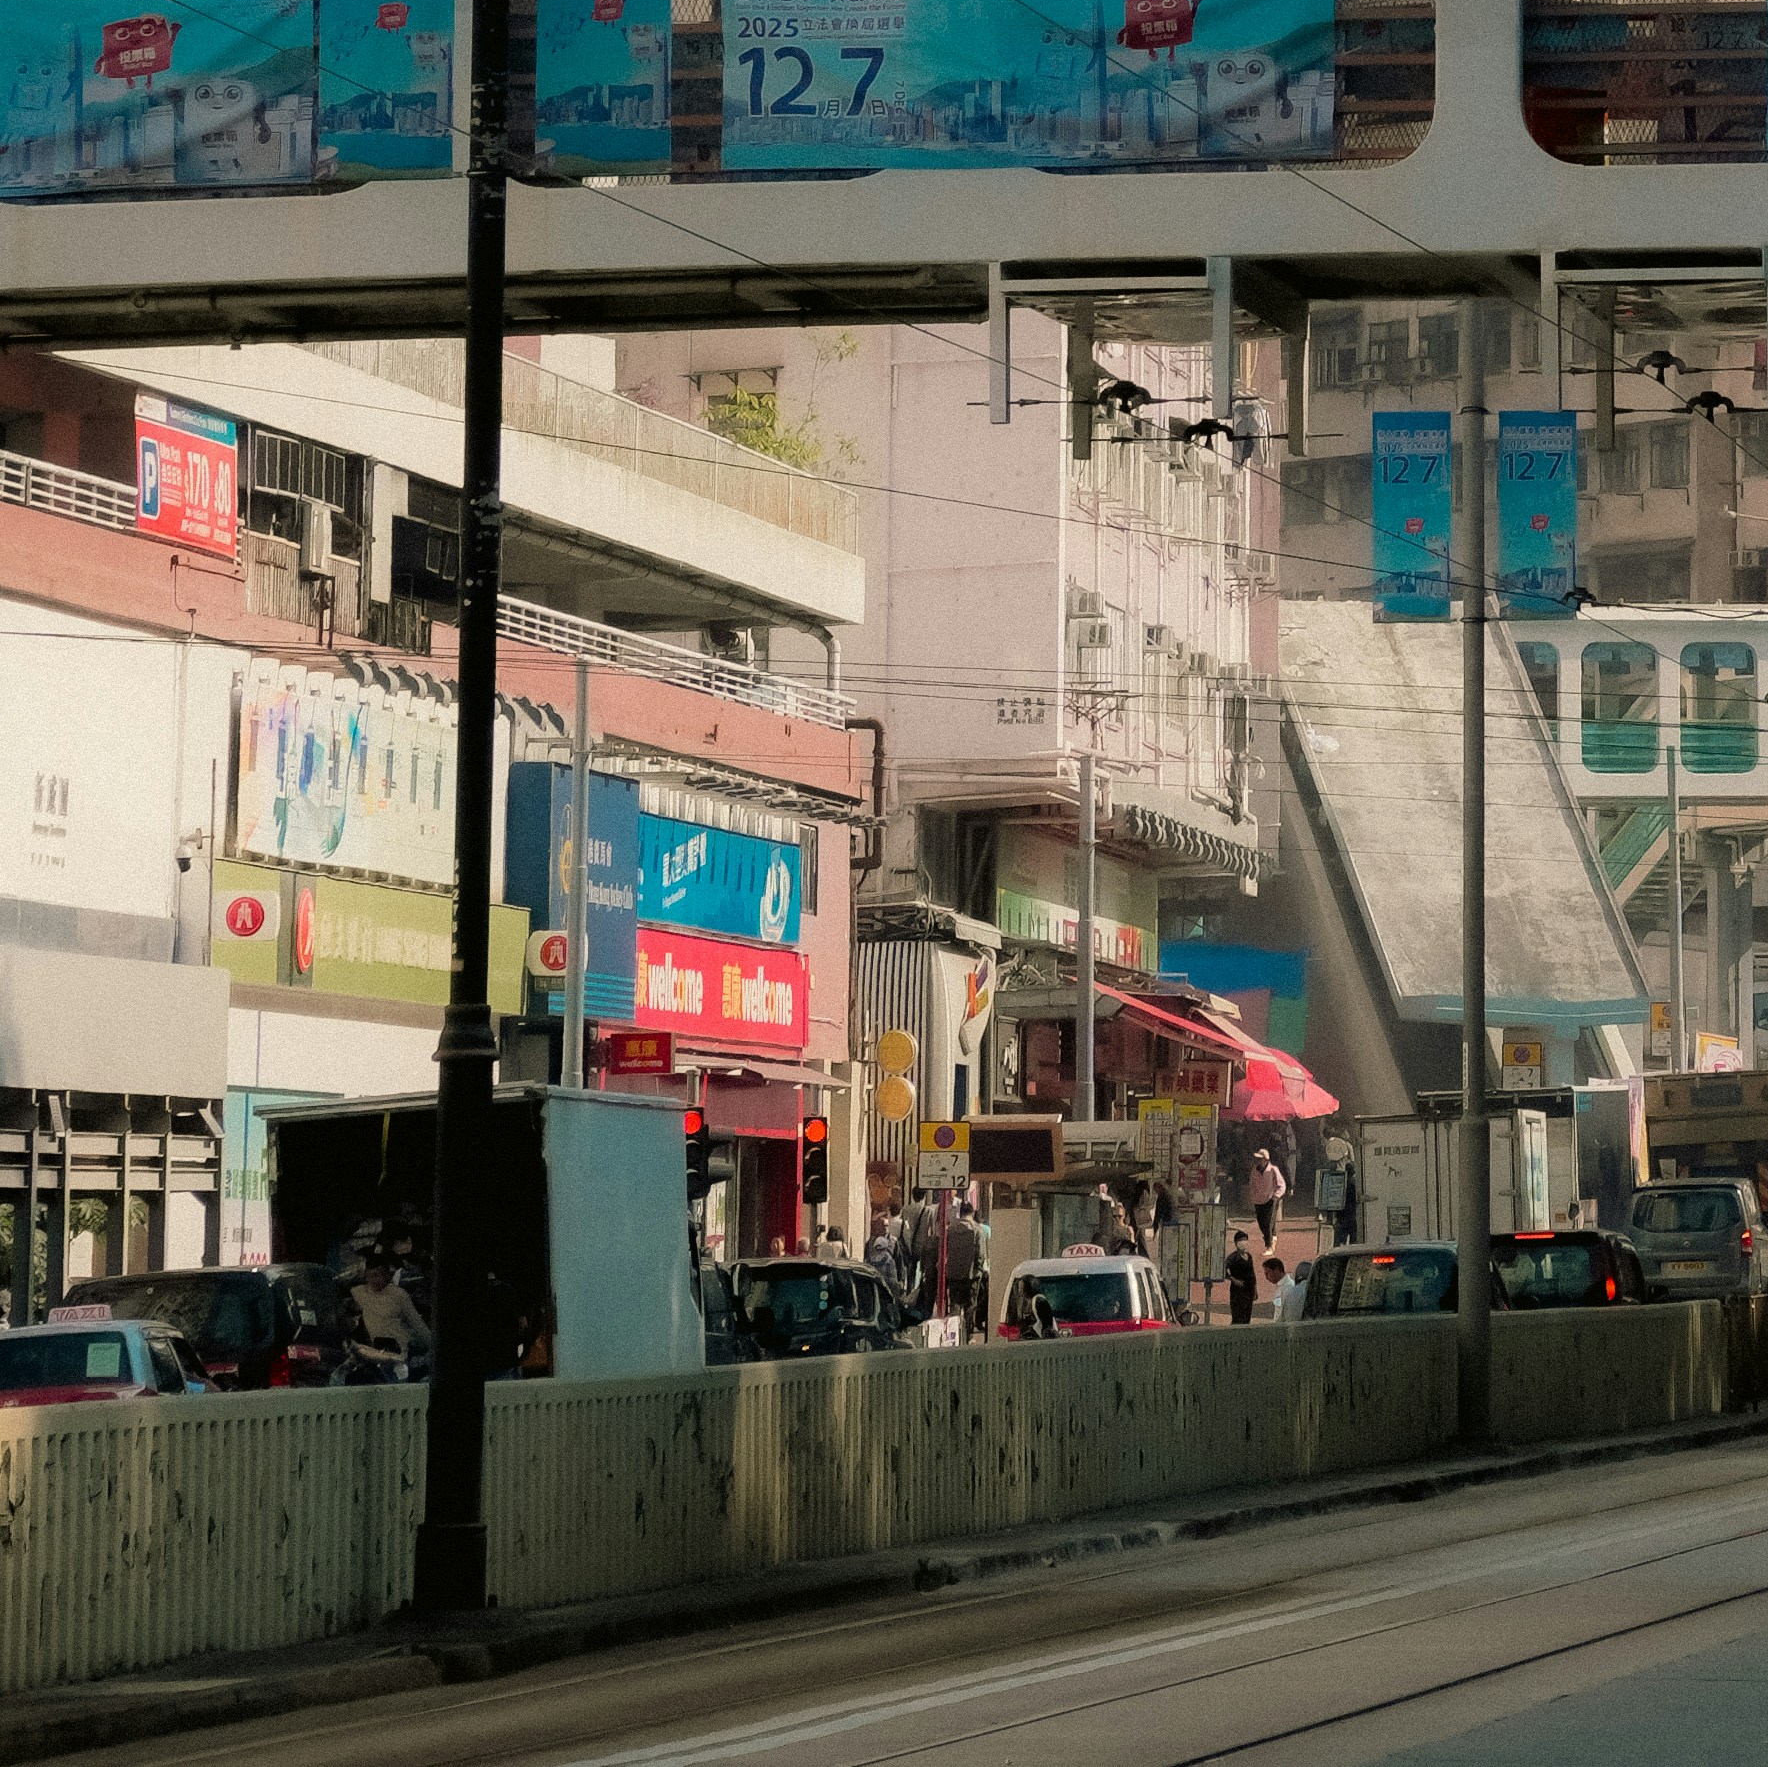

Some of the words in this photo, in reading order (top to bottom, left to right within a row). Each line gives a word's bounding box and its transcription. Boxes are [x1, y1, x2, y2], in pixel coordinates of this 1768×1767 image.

[737, 17, 799, 39] 2025
[1378, 456, 1409, 484] 12
[1420, 456, 1438, 484] 7
[1504, 453, 1535, 481] 12
[1545, 453, 1566, 480] 7
[145, 451, 157, 504] P
[998, 717, 1013, 725] Post
[1028, 717, 1045, 725] Bills
[648, 953, 703, 1016] wellcome
[722, 962, 742, 1019] 惠康
[742, 966, 793, 1026] wellcome
[625, 1039, 658, 1058] 惠康
[950, 1154, 959, 1167] 7
[951, 1175, 966, 1188] 12
[1068, 1246, 1102, 1257] TAXI
[53, 1306, 106, 1321] TAXI
